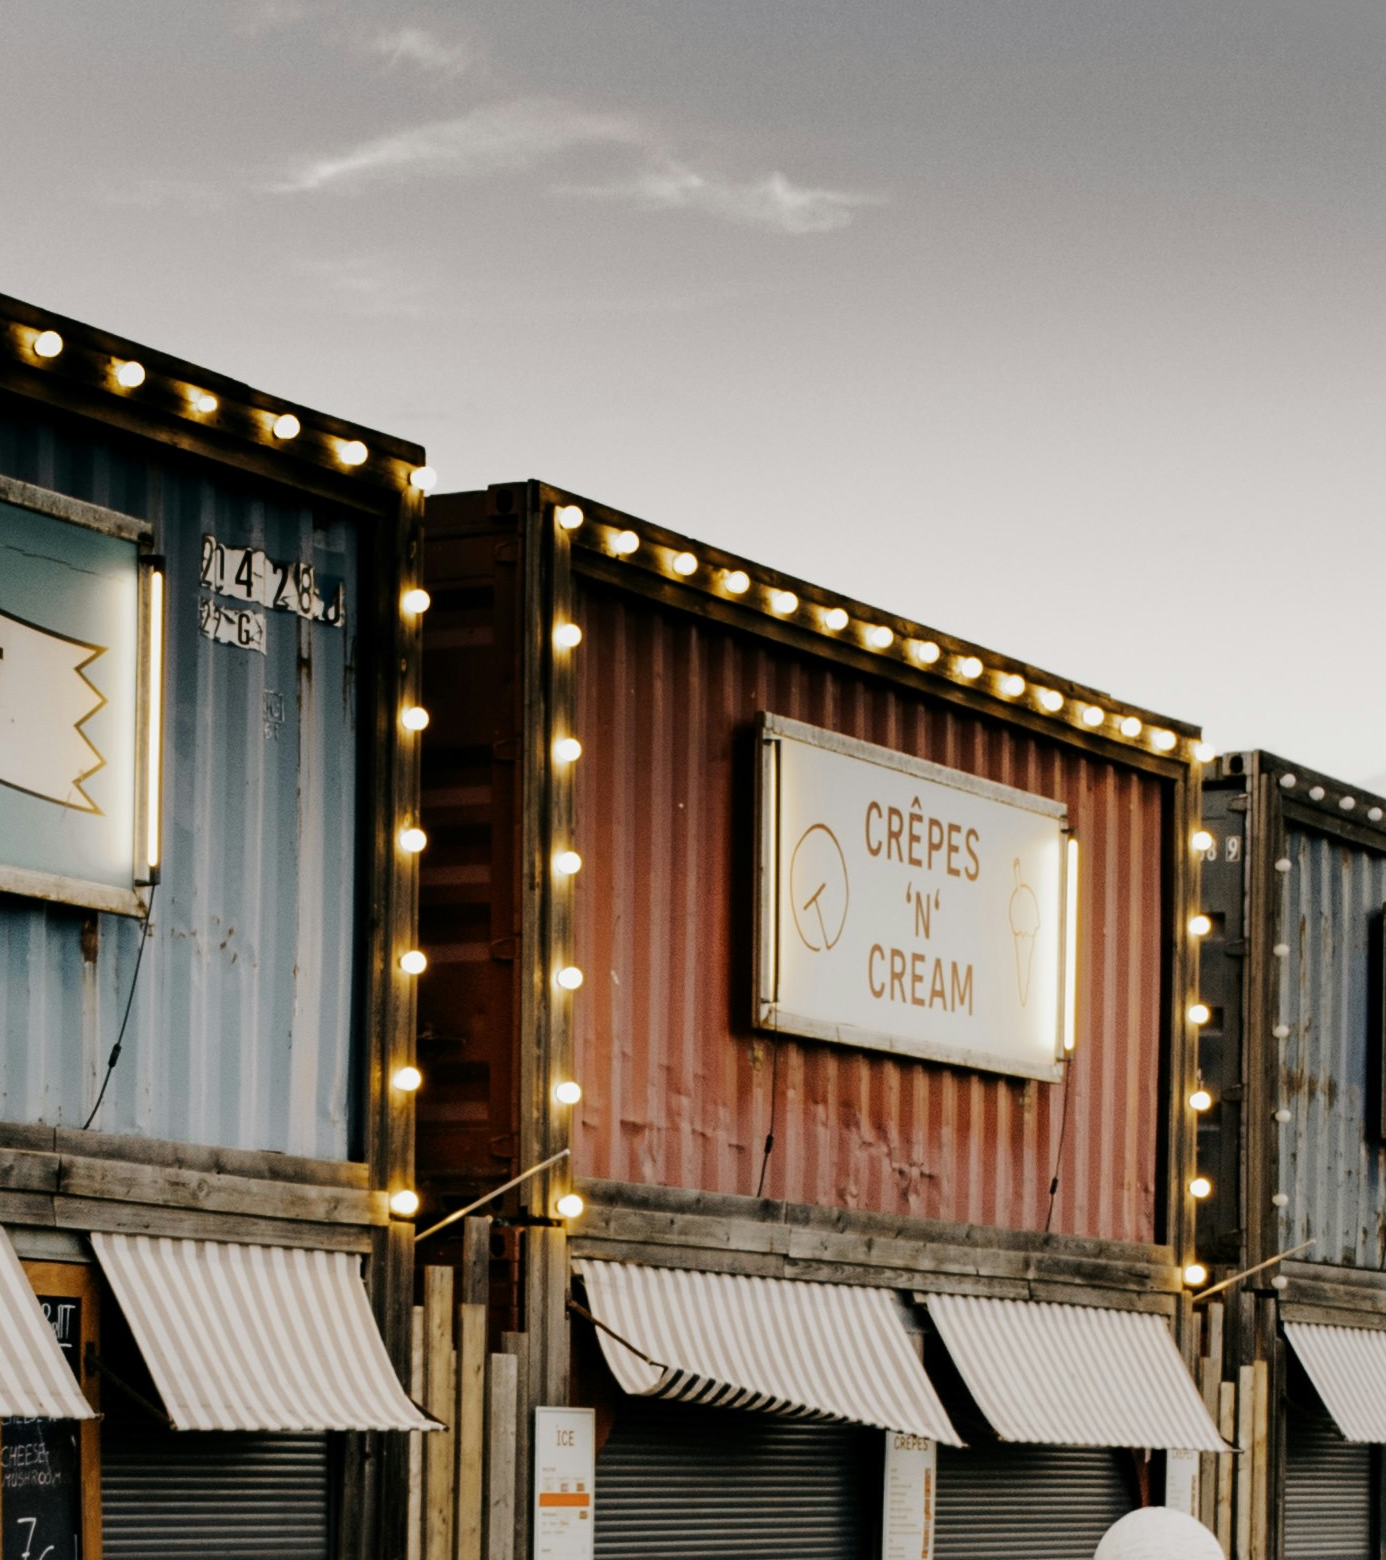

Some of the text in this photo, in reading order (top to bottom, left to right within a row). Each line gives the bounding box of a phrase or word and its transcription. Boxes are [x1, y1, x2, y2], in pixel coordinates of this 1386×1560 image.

[865, 795, 980, 882] CRÊPES
[1227, 836, 1238, 860] 9
[868, 943, 974, 1017] CREAM
[556, 1429, 575, 1448] ICE
